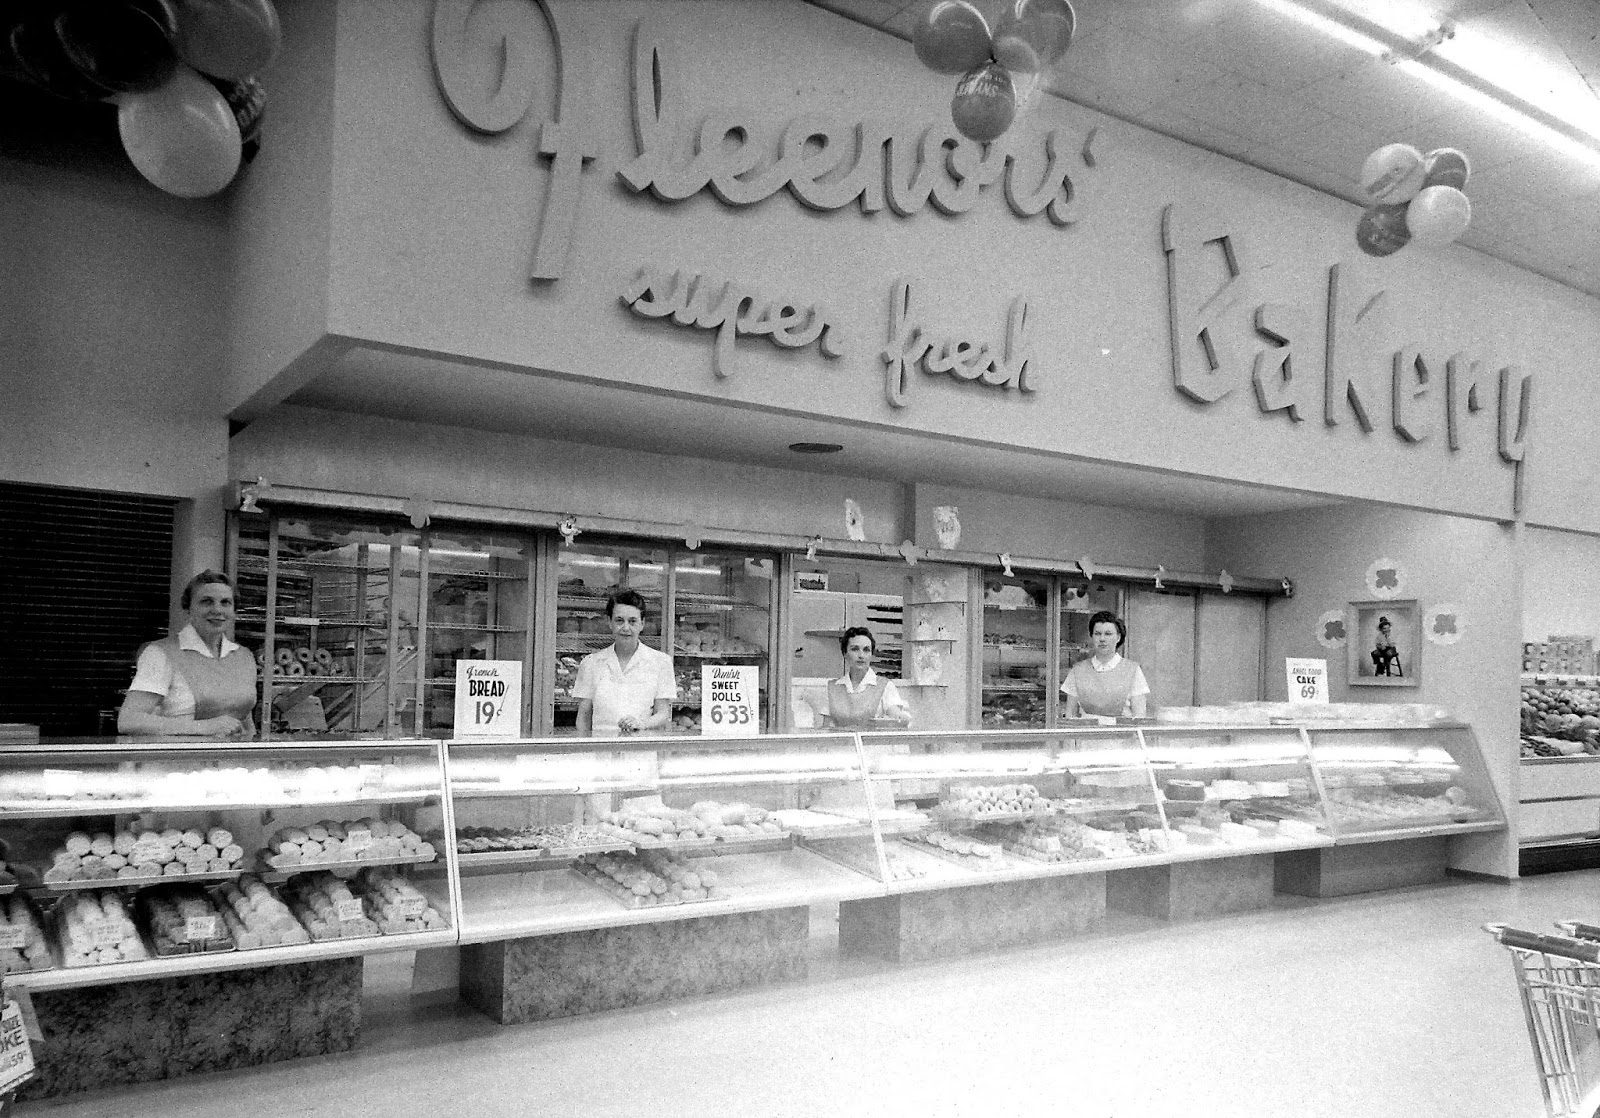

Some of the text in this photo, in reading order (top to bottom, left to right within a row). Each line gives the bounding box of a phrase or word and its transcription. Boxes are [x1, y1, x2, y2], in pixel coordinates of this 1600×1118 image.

[617, 264, 1037, 408] super fresh
[466, 665, 499, 679] French
[712, 668, 741, 679] Danish
[711, 681, 739, 690] SWEET
[1296, 675, 1316, 685] CAKE
[469, 680, 505, 697] BREAD
[711, 692, 742, 702] ROLLS
